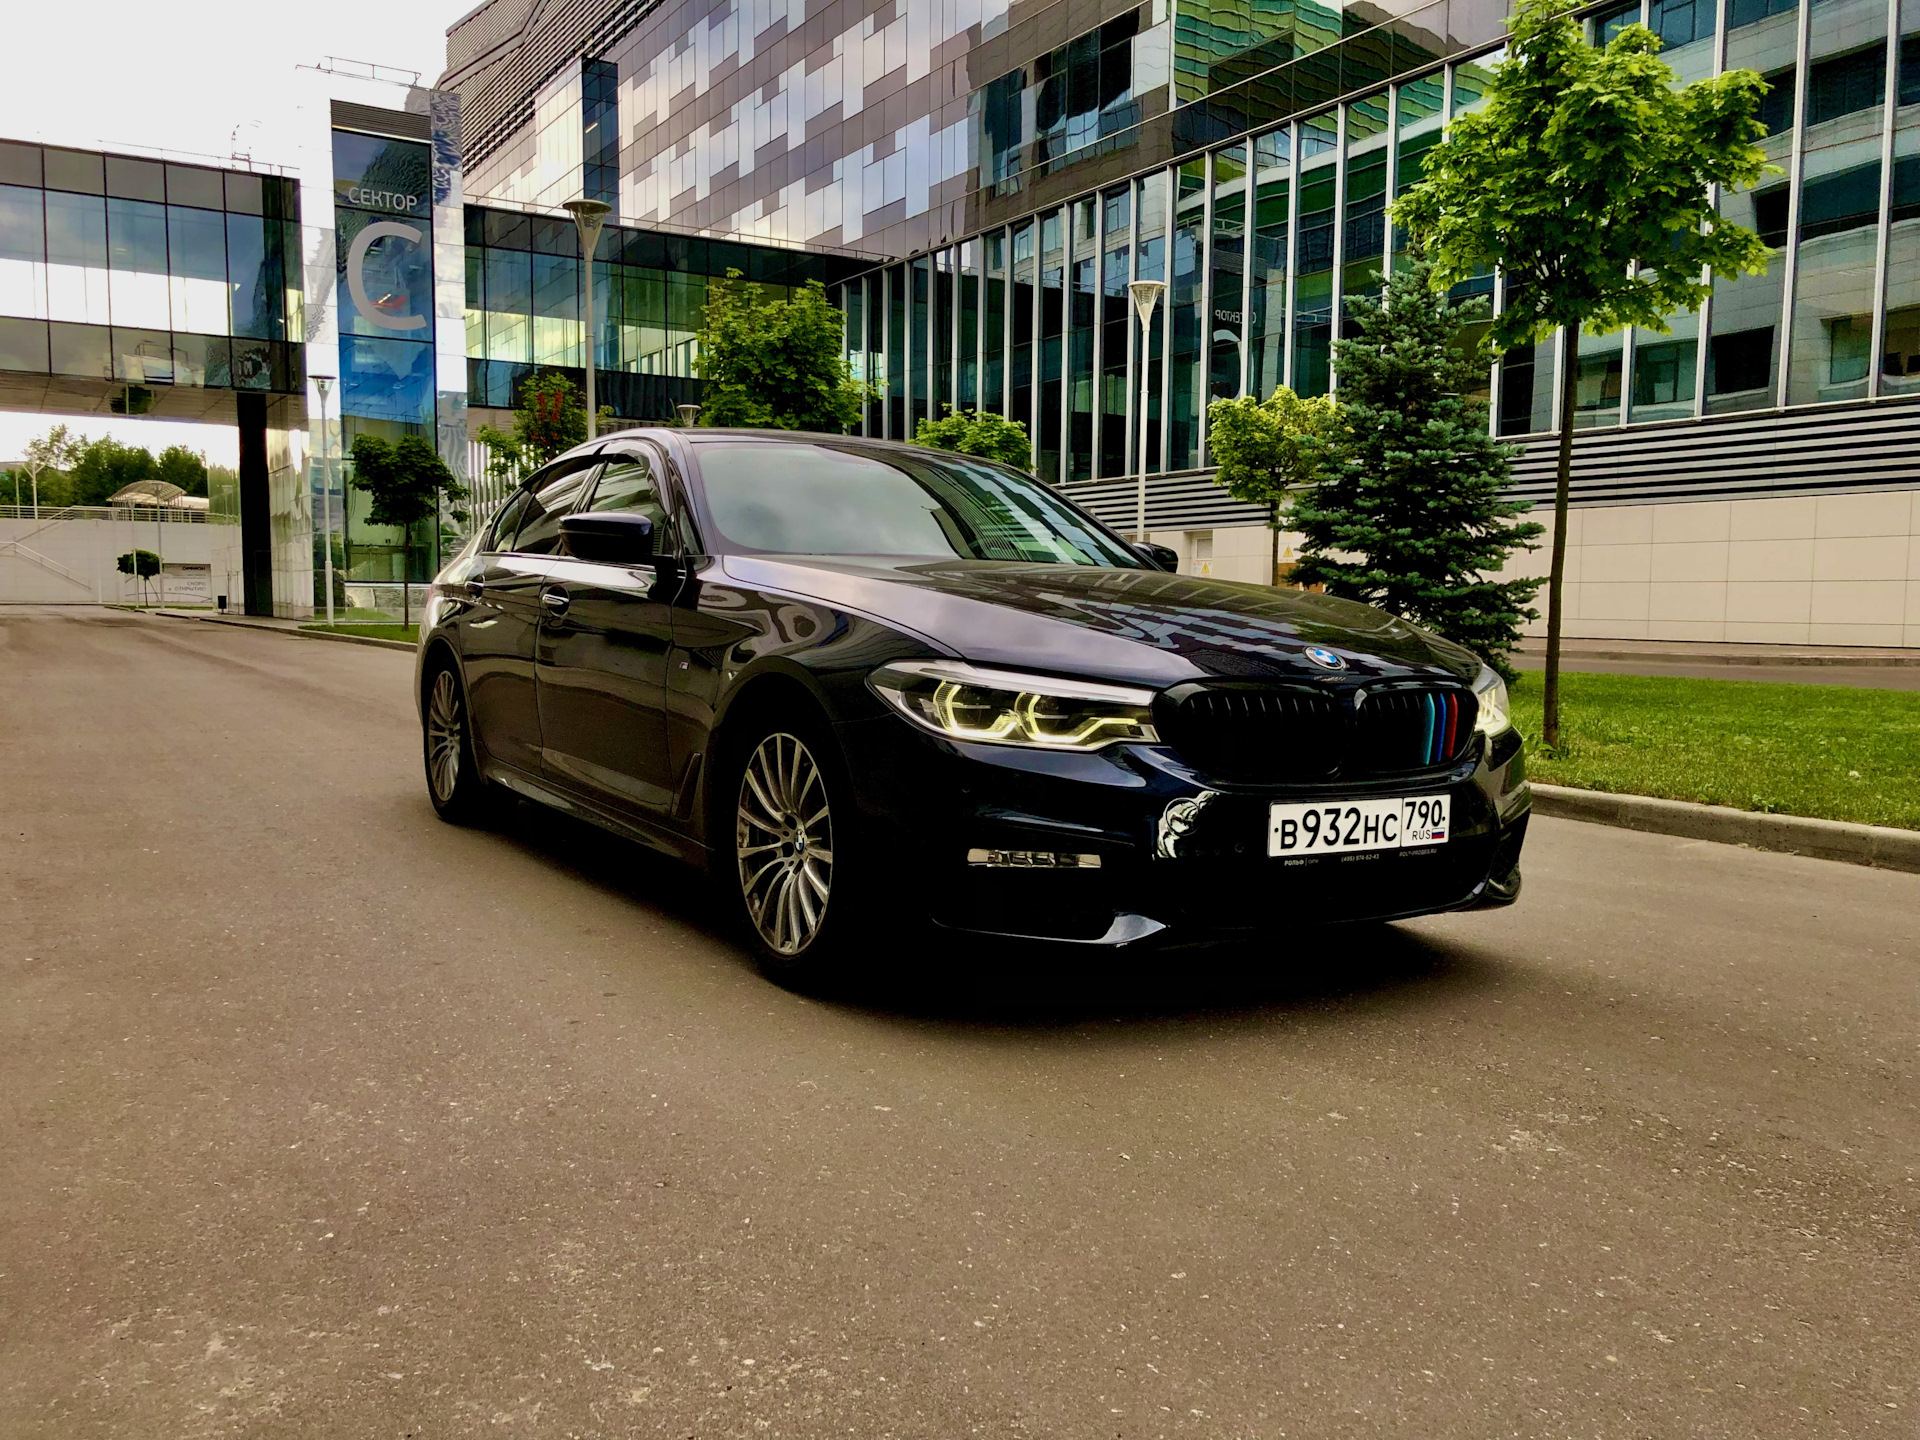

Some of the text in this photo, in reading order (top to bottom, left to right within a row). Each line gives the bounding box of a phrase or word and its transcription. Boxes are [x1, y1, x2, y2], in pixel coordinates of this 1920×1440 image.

[348, 187, 418, 212] СЕКТОР
[346, 221, 427, 331] С
[1280, 800, 1443, 849] В932НС 790
[1412, 829, 1431, 840] RUS
